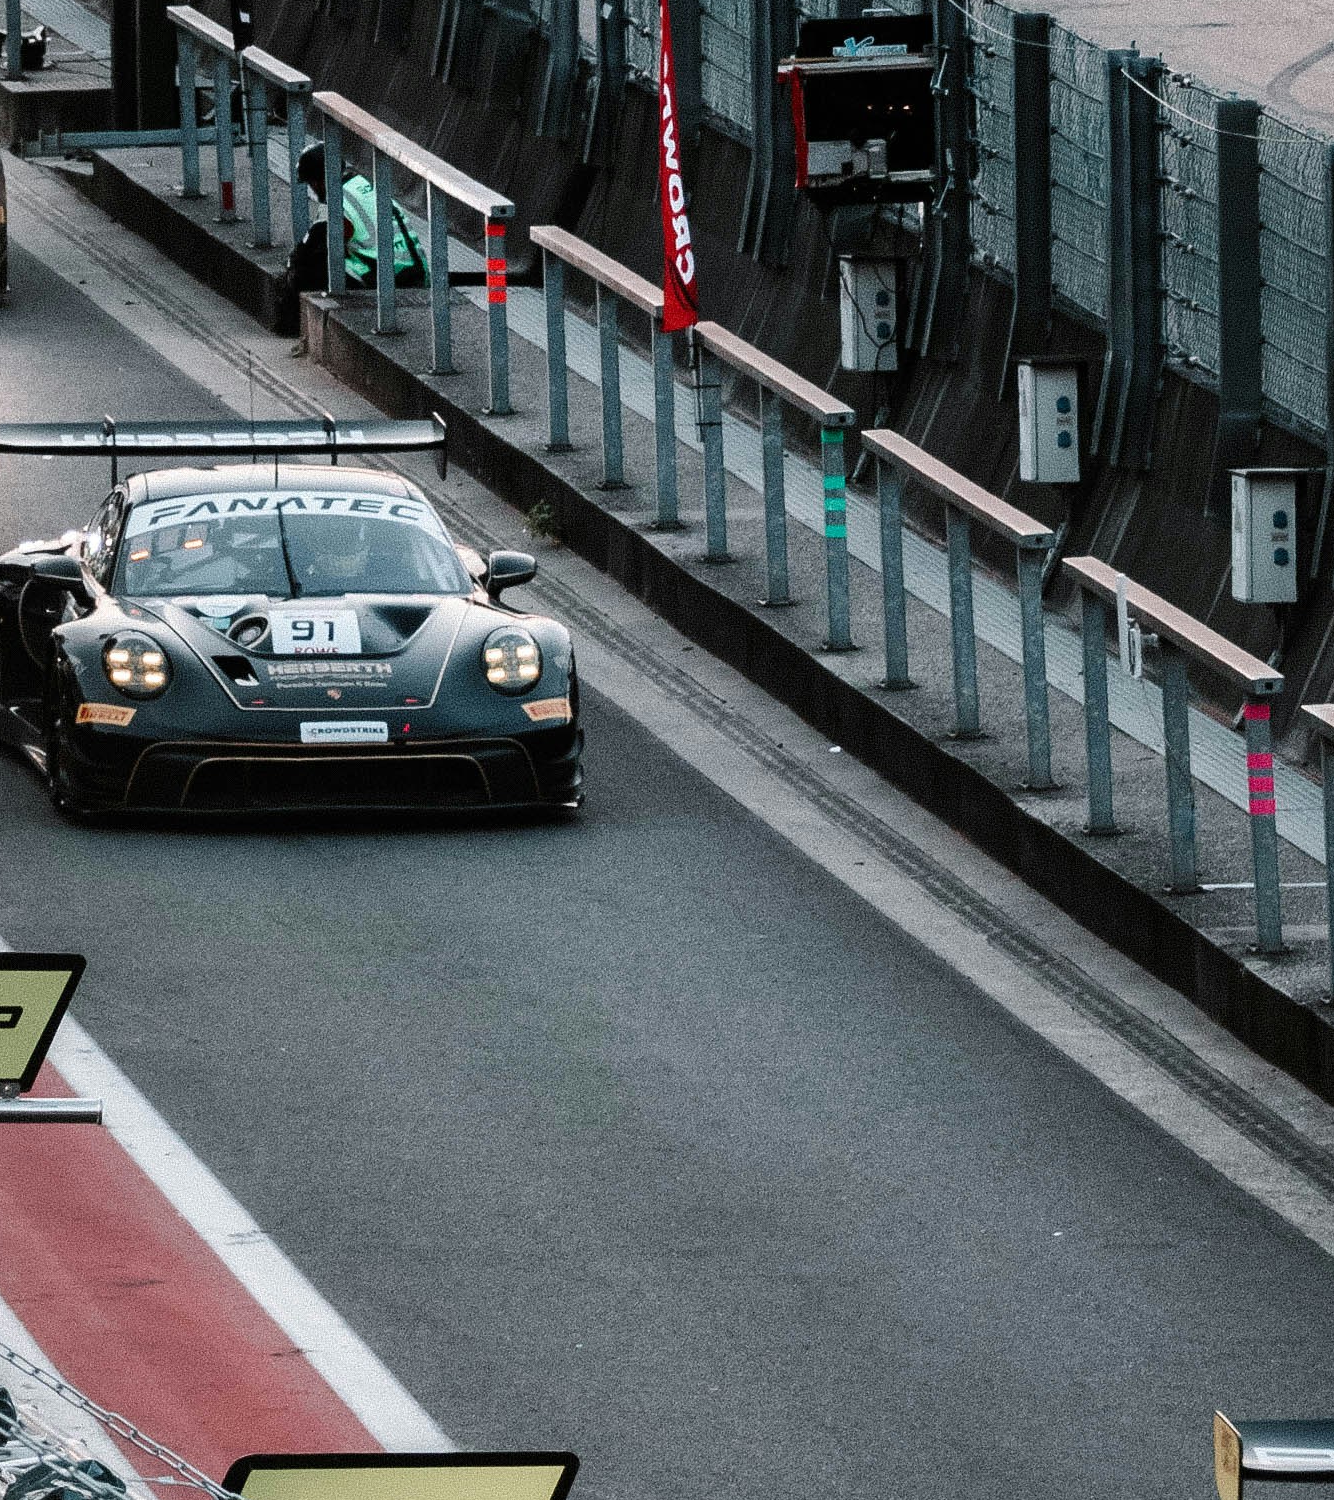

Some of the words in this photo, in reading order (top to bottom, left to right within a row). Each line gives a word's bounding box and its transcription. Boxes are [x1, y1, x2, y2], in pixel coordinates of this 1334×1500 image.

[149, 497, 424, 526] FANATEC
[291, 620, 335, 642] 91
[267, 662, 393, 675] HERBERTH
[310, 726, 385, 735] CROWDSTRIKE
